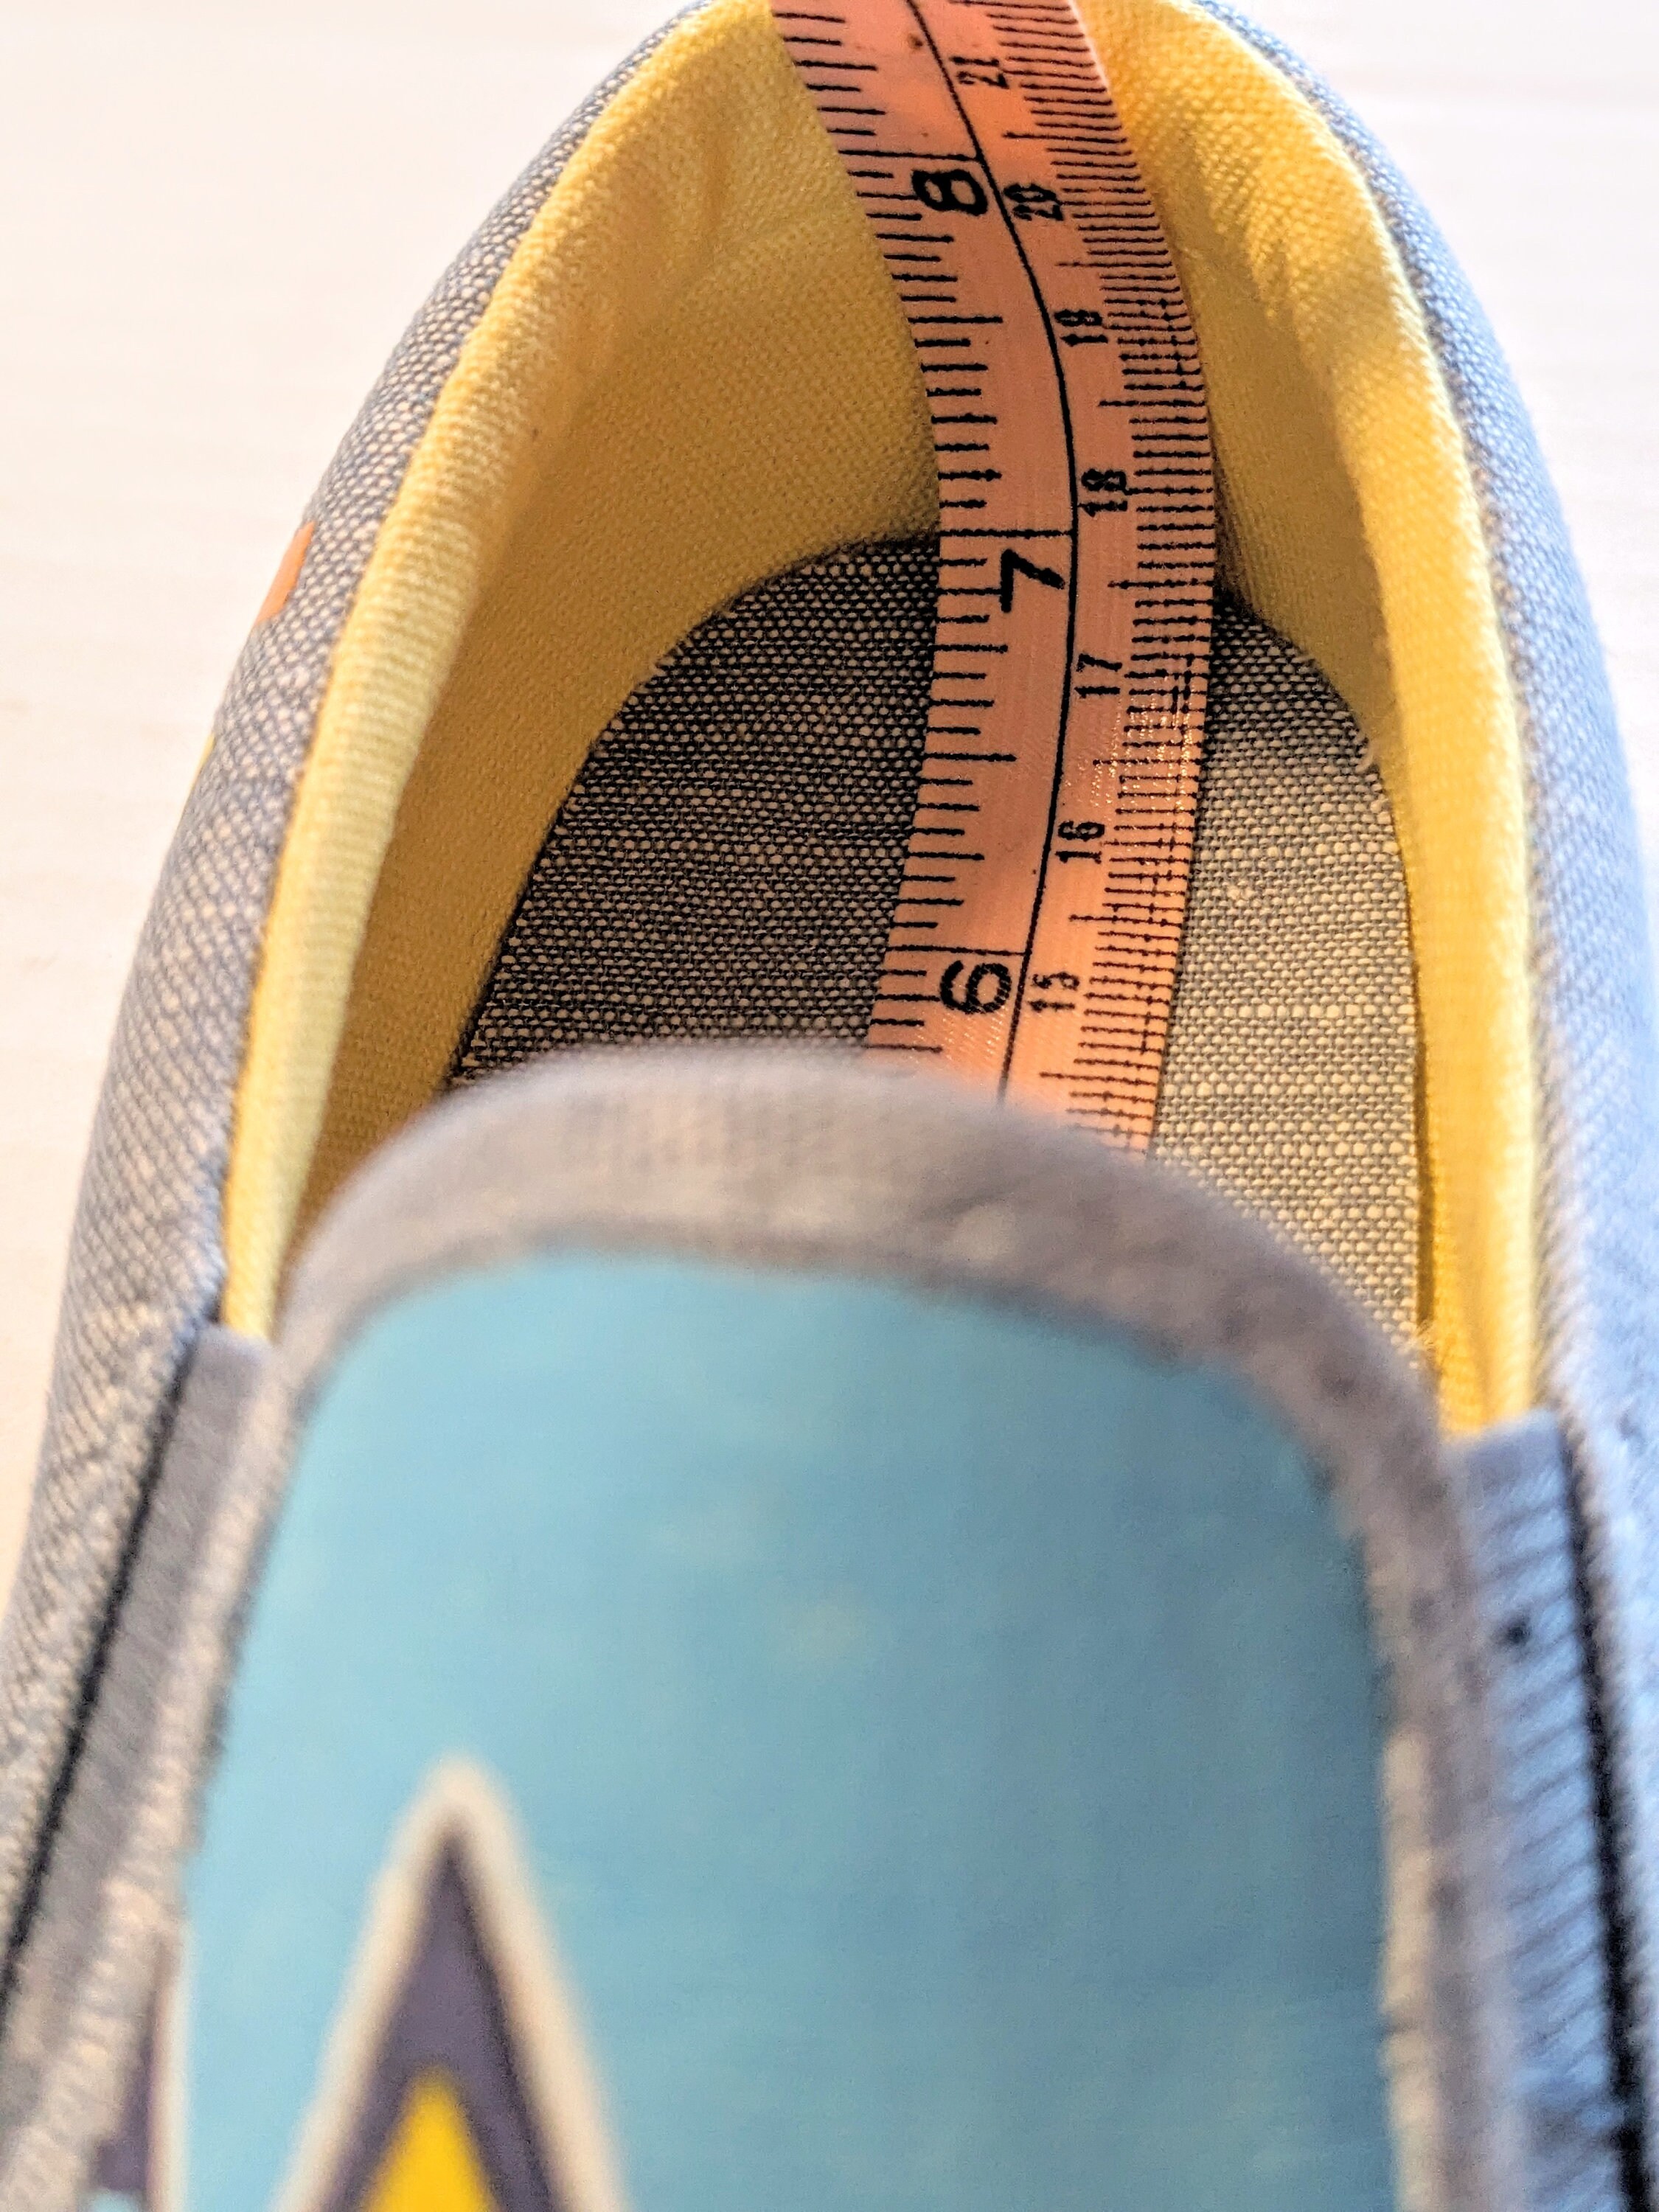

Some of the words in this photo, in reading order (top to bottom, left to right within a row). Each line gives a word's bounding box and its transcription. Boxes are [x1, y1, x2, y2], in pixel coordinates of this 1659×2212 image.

[948, 56, 1009, 89] 21
[911, 170, 988, 215] 8
[1003, 182, 1063, 221] 20
[1054, 309, 1108, 347] 19
[1078, 467, 1128, 517] 18
[999, 549, 1065, 613] 7
[1074, 653, 1123, 698] 17
[1054, 821, 1106, 864] 16
[939, 960, 1012, 1015] 6
[1028, 971, 1080, 1013] 15
